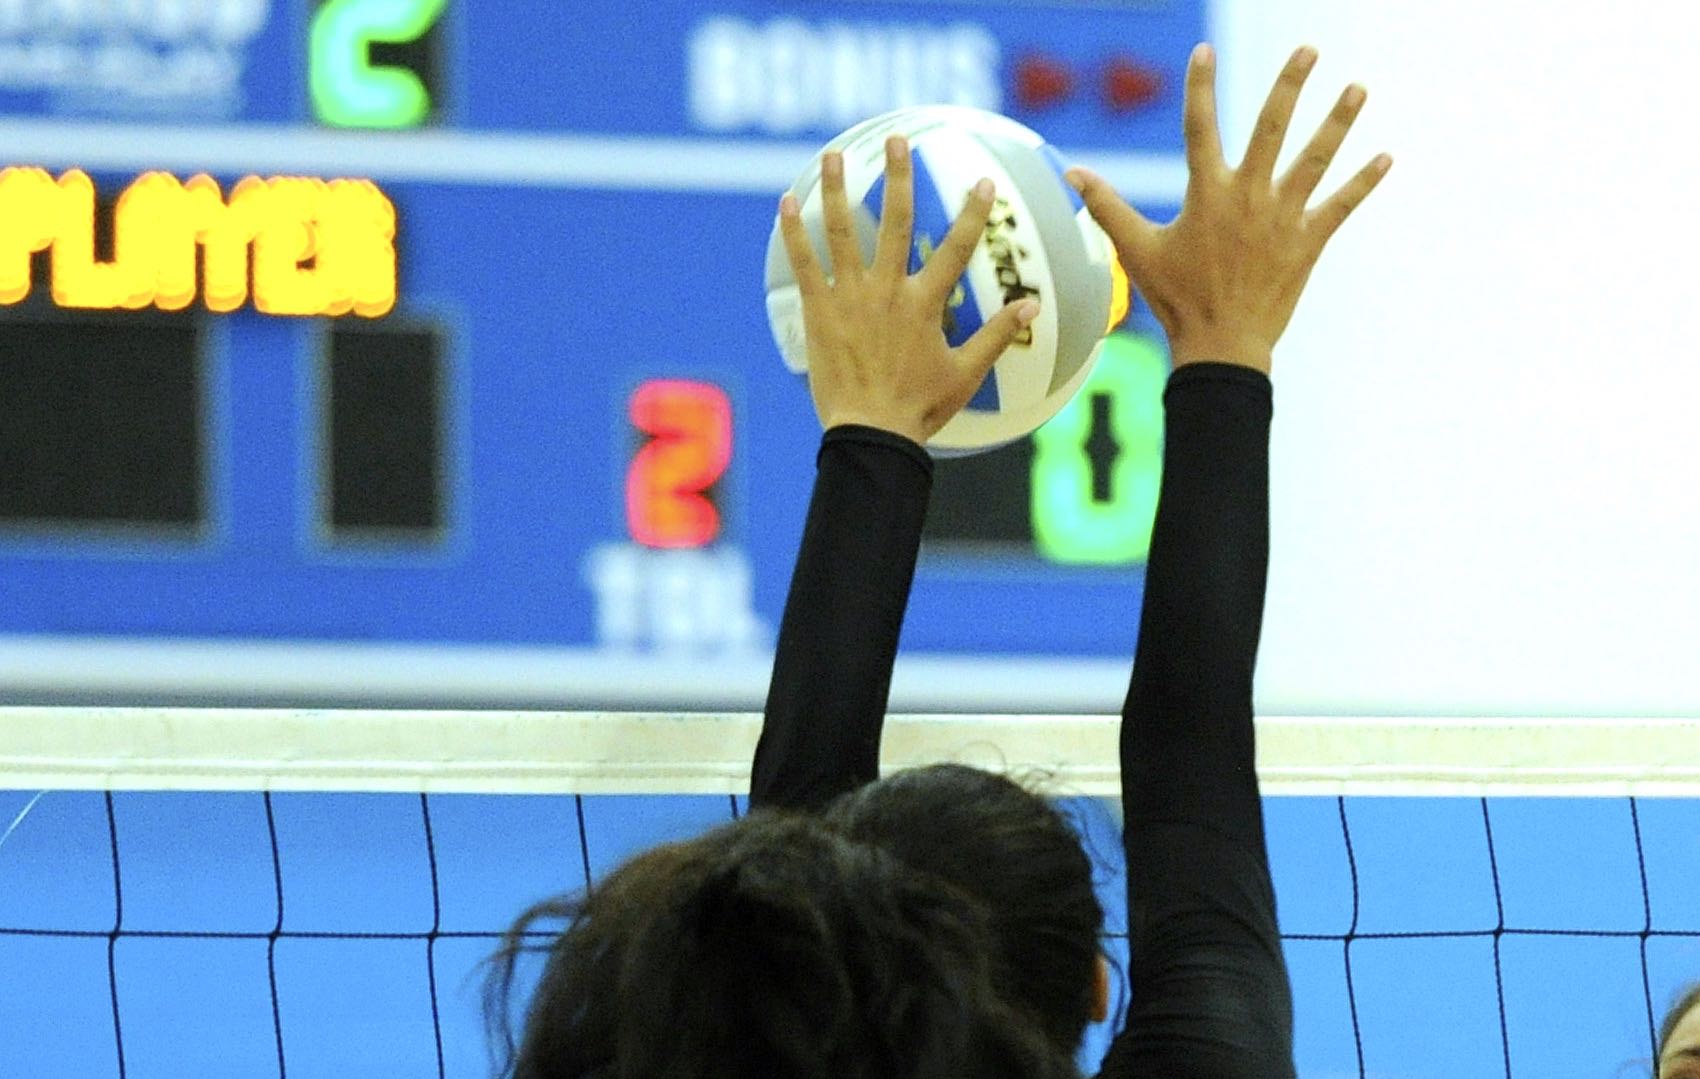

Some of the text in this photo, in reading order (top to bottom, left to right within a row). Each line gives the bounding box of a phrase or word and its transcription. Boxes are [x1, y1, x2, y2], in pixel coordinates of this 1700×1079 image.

[690, 16, 998, 130] BONUS
[0, 166, 396, 317] PLAYER
[625, 378, 733, 549] 2
[1030, 335, 1168, 563] 0
